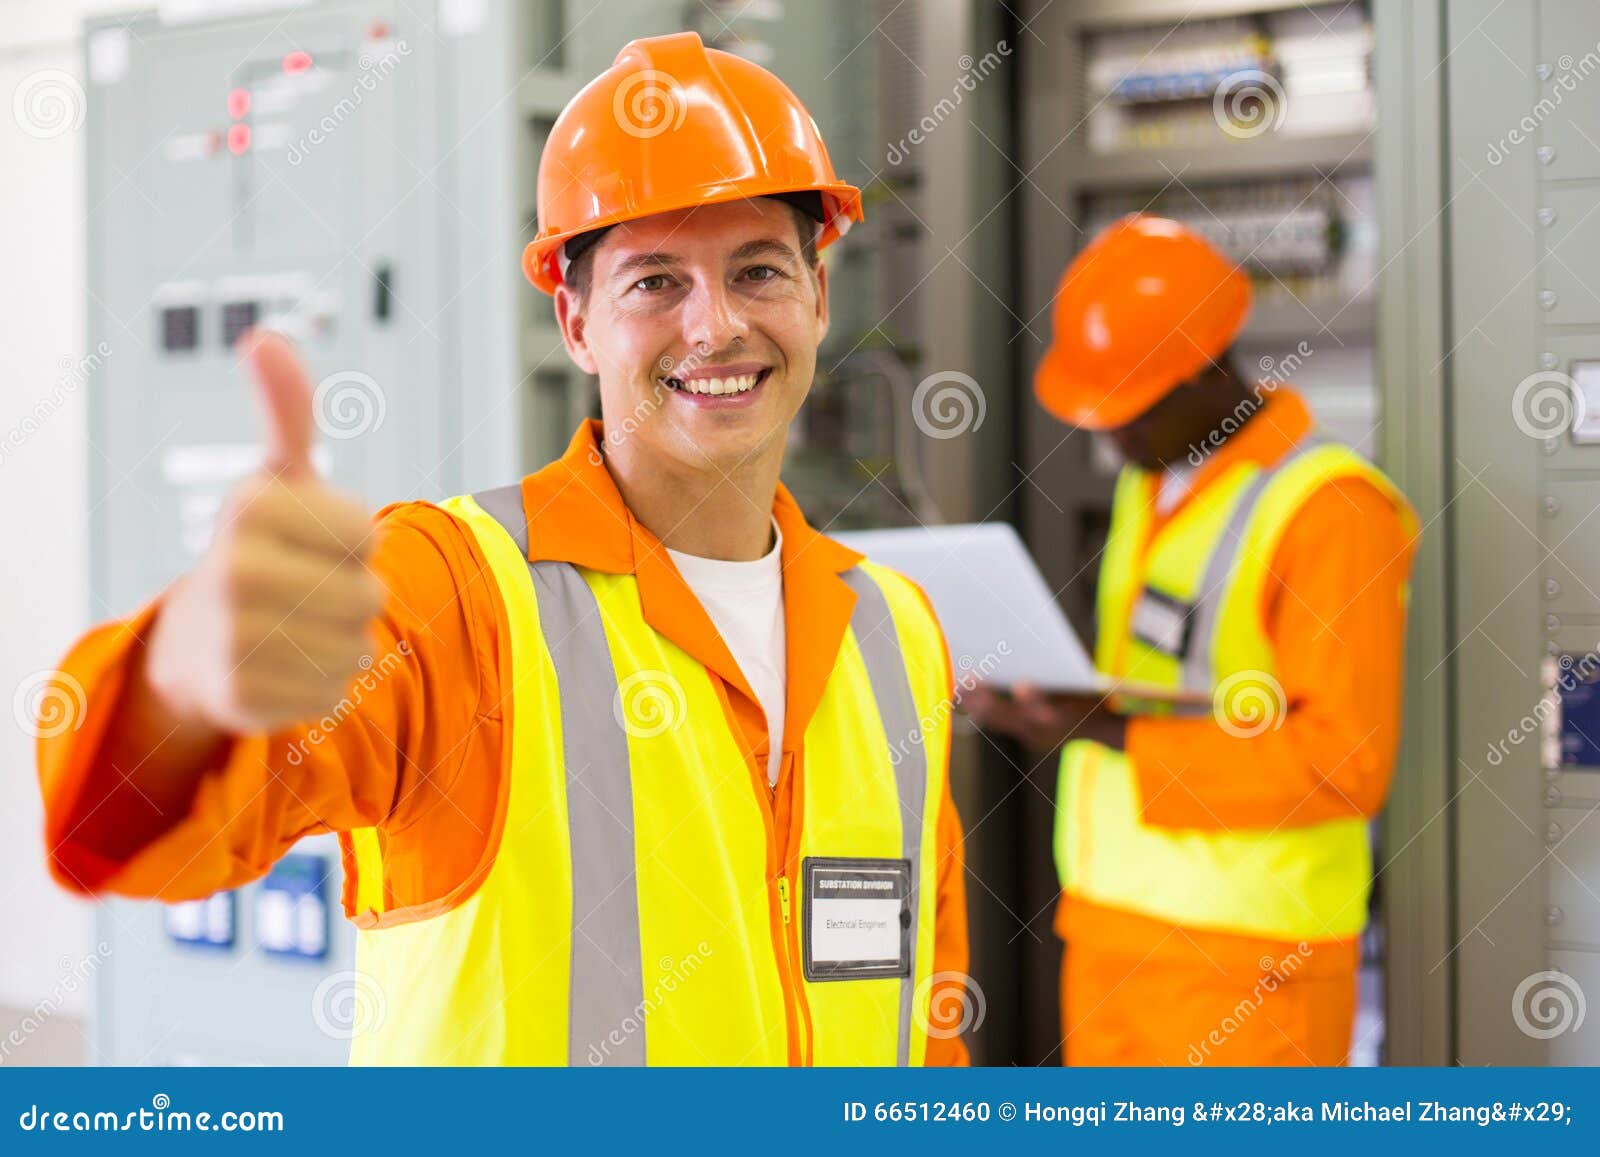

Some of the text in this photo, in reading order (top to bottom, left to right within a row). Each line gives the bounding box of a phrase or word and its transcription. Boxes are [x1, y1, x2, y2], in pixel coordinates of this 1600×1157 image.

[819, 880, 894, 890] SUBSTATION DIVISION
[826, 919, 857, 929] Electrical
